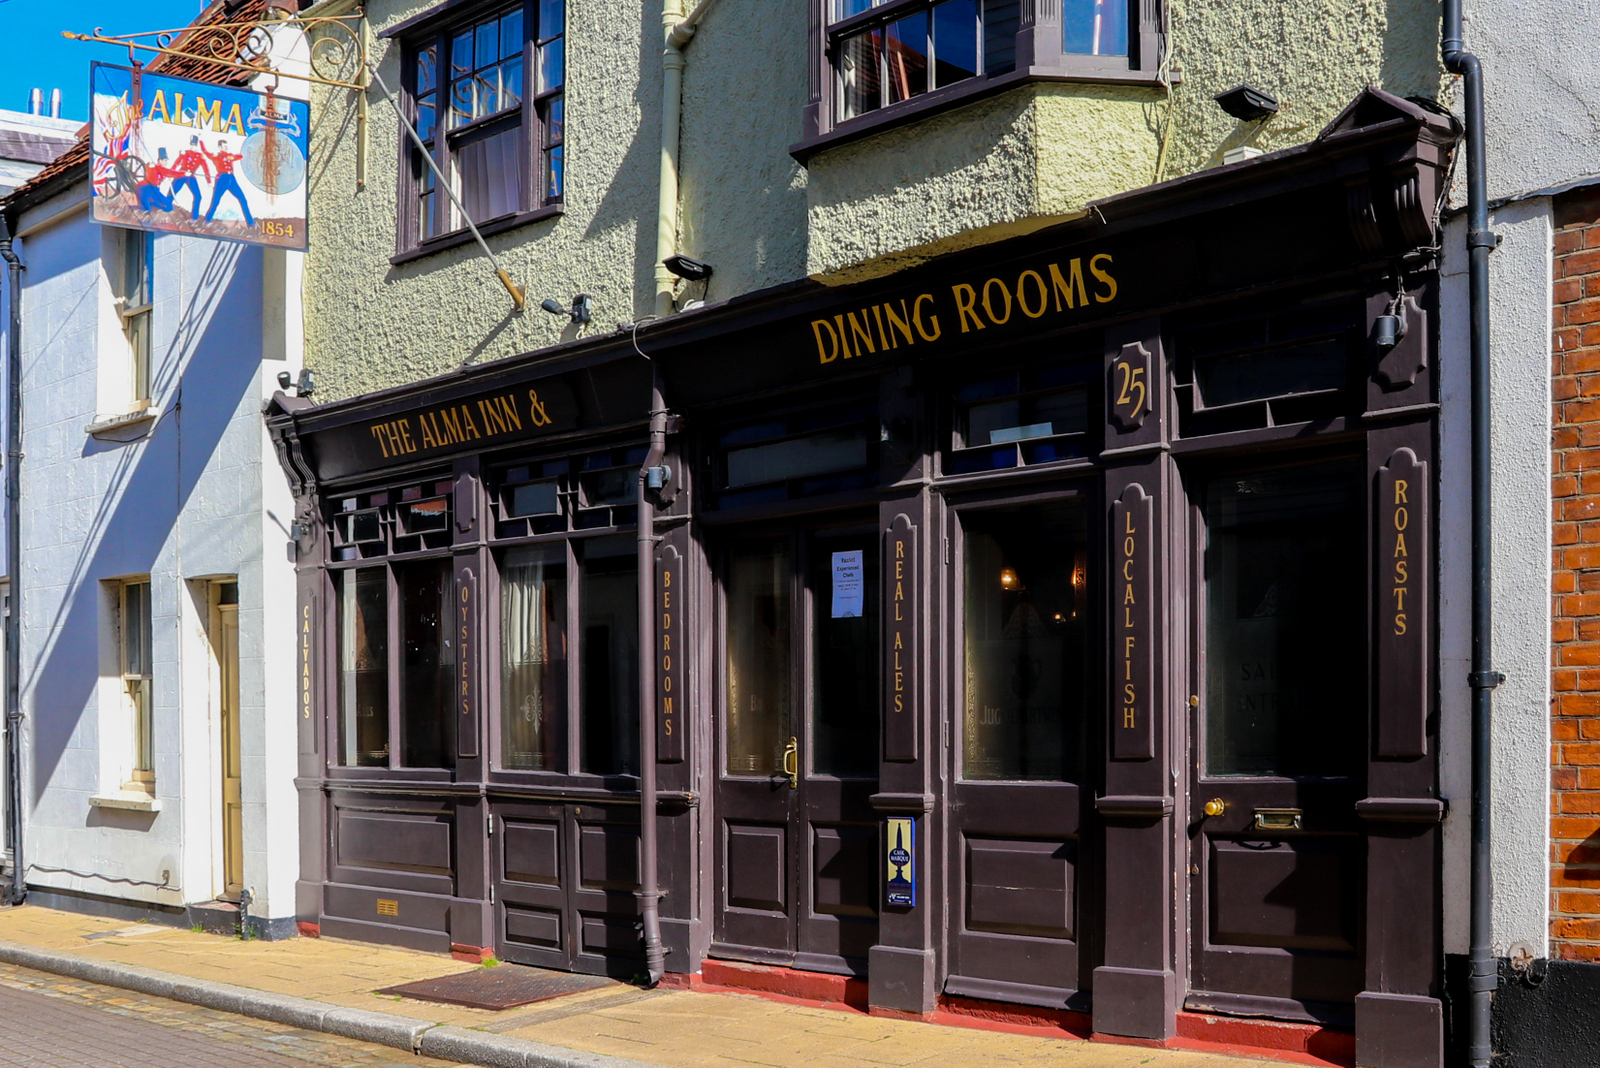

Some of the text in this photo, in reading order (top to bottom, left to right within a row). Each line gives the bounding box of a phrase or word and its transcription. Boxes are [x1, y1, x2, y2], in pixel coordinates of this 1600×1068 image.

[105, 89, 246, 139] The ALMA
[264, 111, 284, 120] ALMA
[261, 220, 294, 237] 1854
[811, 253, 1118, 365] DINING ROOMS
[370, 389, 552, 458] THE ALMA INN &
[1116, 361, 1145, 419] 25
[1393, 479, 1408, 636] ROASTS
[461, 586, 469, 715] OYSTERS
[663, 571, 672, 736] BEDROOMS
[894, 540, 904, 713] REAL ALES
[1122, 511, 1136, 729] LOCAL FISH
